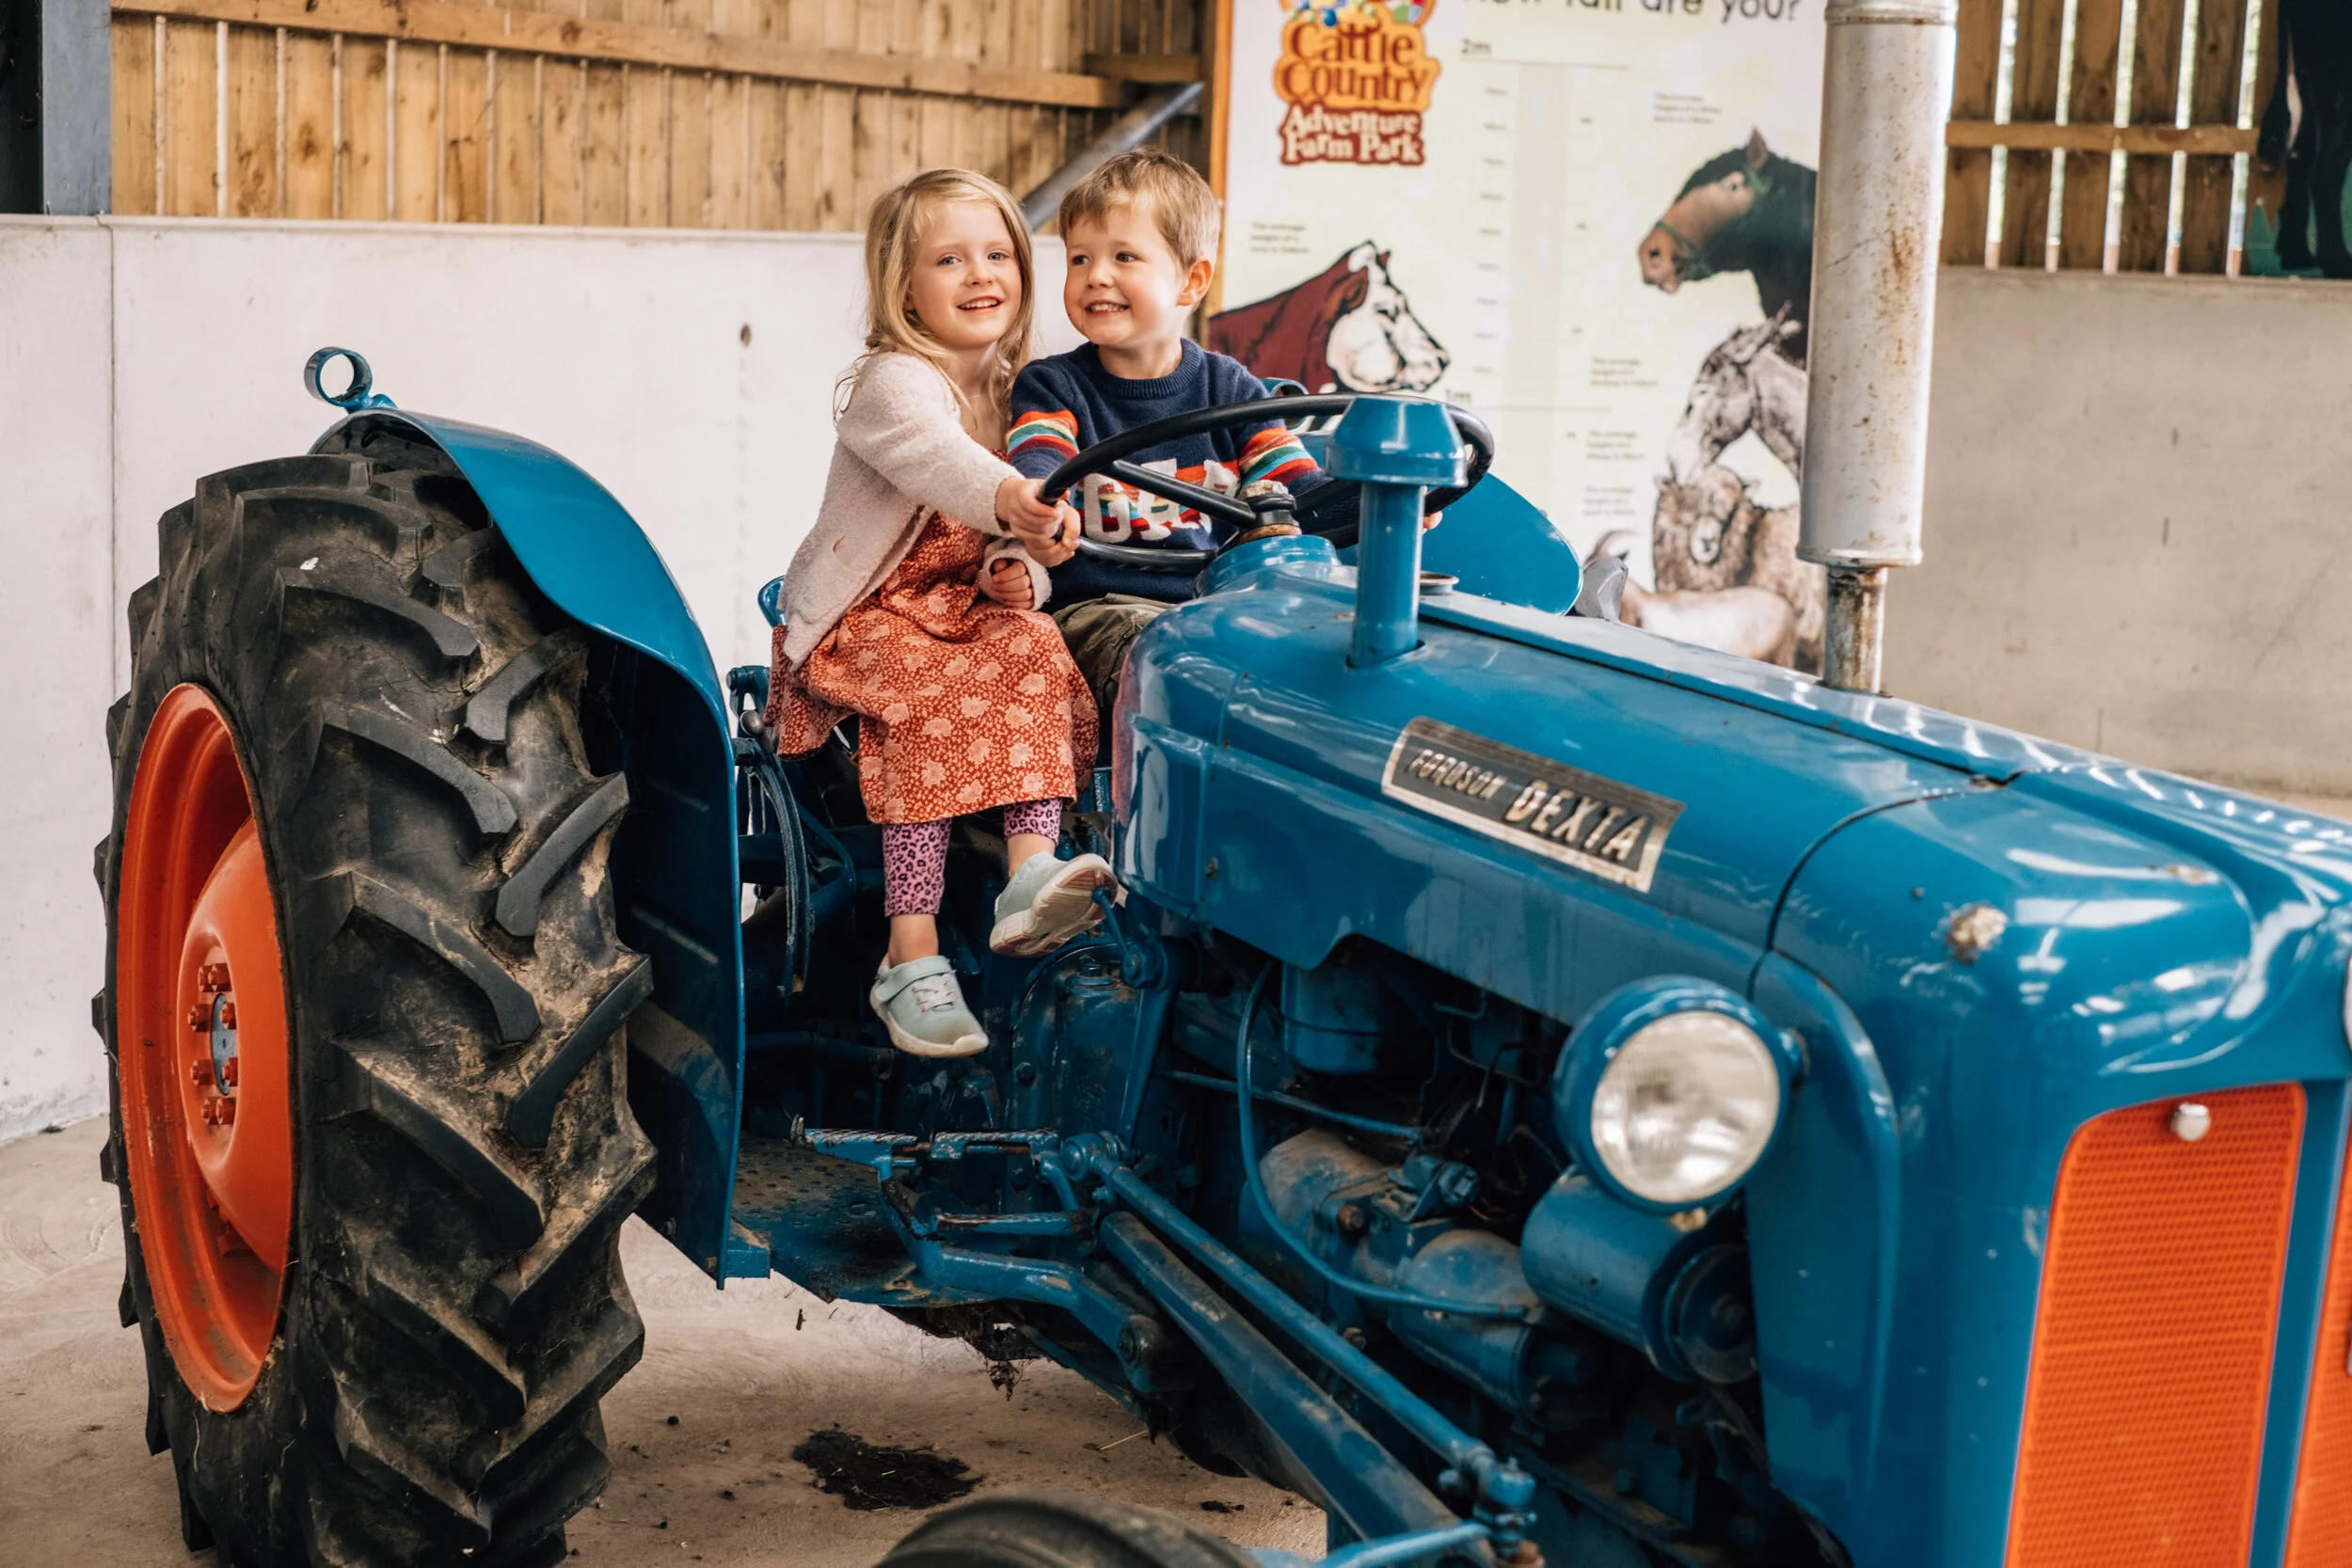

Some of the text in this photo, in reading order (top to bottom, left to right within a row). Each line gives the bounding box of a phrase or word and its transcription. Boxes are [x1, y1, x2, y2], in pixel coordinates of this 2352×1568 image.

[1291, 20, 1414, 67] Cattle
[1282, 61, 1429, 103] Country
[1285, 104, 1420, 137] Adventure
[1286, 131, 1420, 163] Farm Park
[1407, 749, 1648, 862] FORDSON DEXTA
